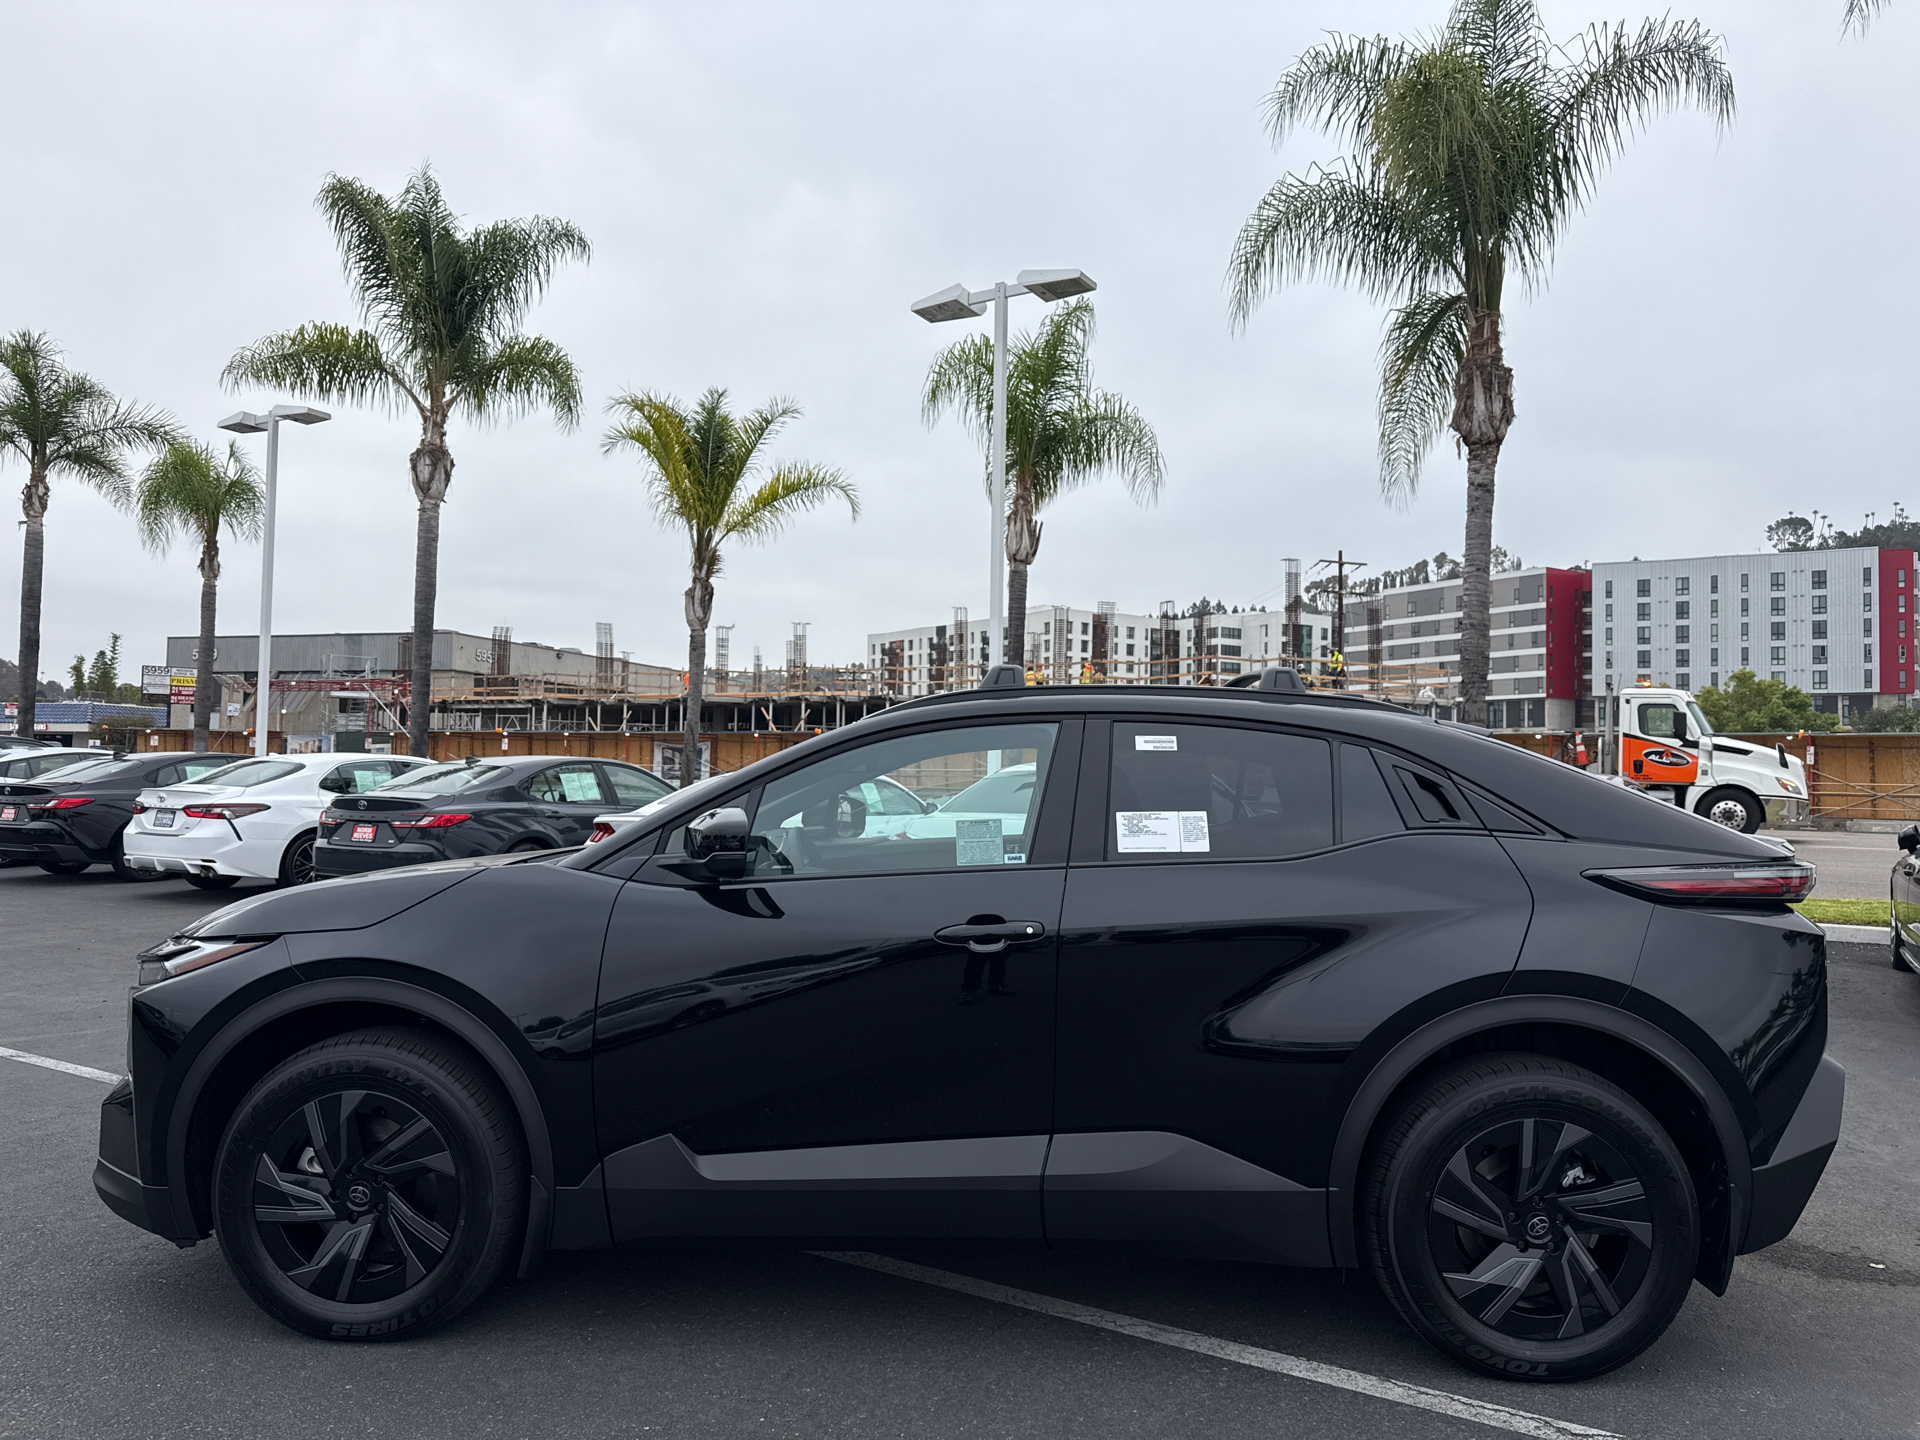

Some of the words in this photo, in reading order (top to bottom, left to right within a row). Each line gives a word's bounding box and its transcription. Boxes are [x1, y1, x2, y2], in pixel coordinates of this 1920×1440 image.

[192, 649, 218, 660] 59
[476, 649, 494, 663] 595
[144, 666, 170, 675] 5959
[171, 686, 178, 694] 21
[250, 1060, 371, 1124] COUNTRY
[384, 1066, 442, 1099] H/T
[1465, 1085, 1550, 1118] OPEN
[1561, 1089, 1678, 1184] COUNTRY
[331, 1312, 417, 1337] TIRES
[1465, 1344, 1549, 1376] TOYO
